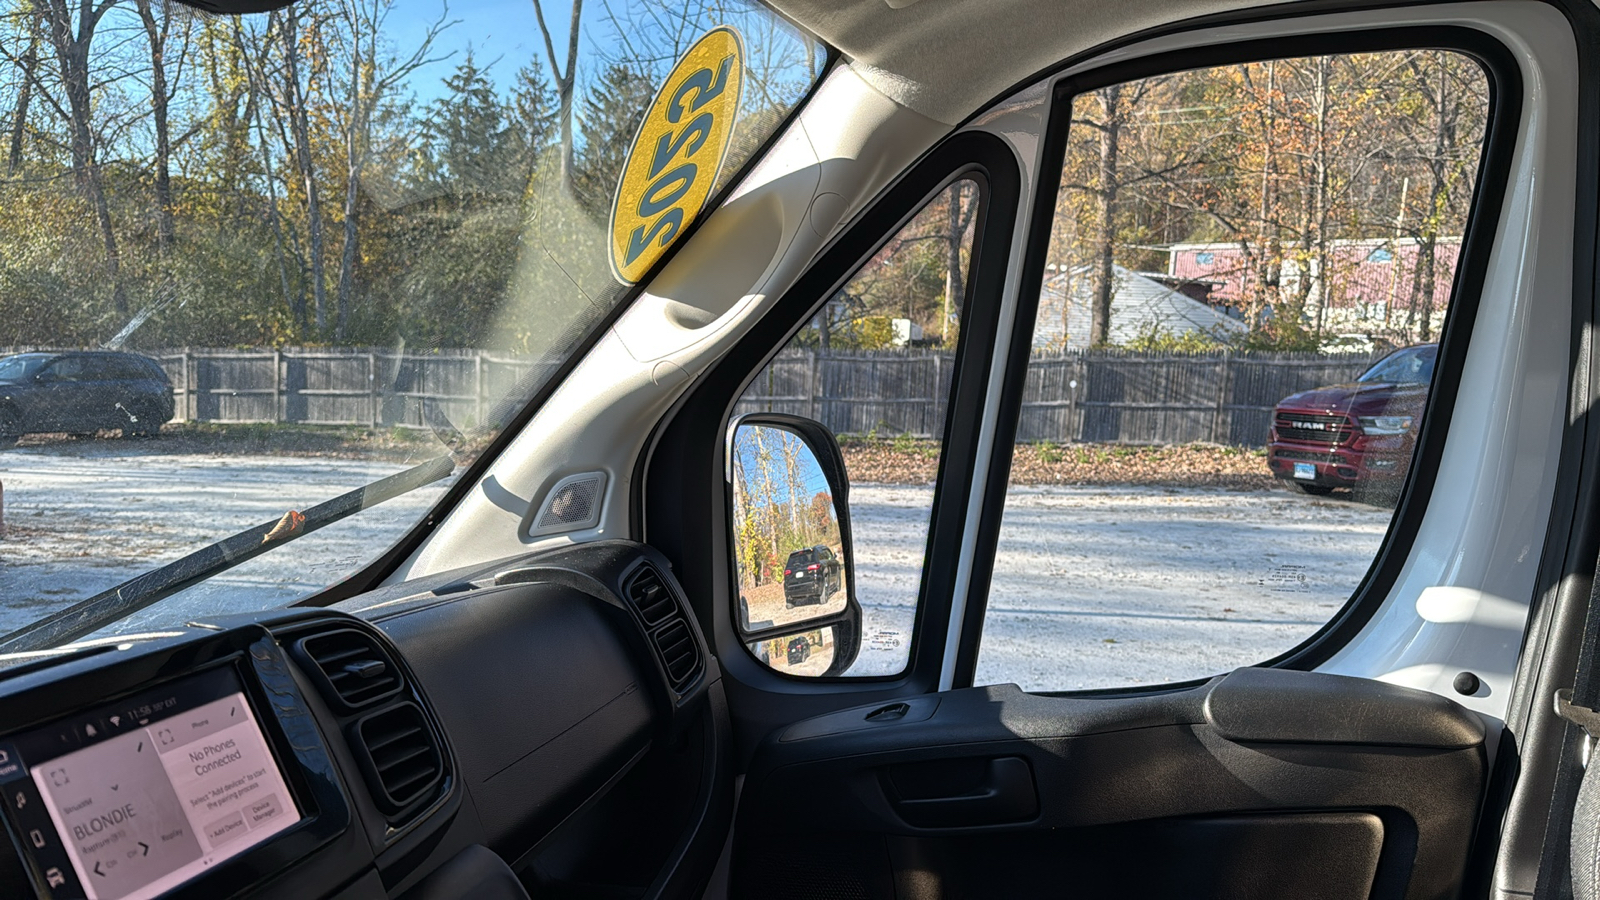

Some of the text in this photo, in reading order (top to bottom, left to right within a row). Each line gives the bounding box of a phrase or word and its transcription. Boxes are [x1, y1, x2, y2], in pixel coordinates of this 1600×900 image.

[1292, 420, 1325, 430] RAM
[191, 719, 210, 729] Phone
[189, 739, 236, 763] No Phones
[195, 749, 242, 776] Connected
[190, 793, 209, 807] Select
[247, 773, 254, 781] to
[253, 767, 267, 778] start
[206, 782, 259, 810] the pairing process
[252, 802, 270, 813] Device
[253, 808, 276, 821] Manager
[73, 803, 137, 841] BLONDIE
[213, 820, 243, 838] Add Device
